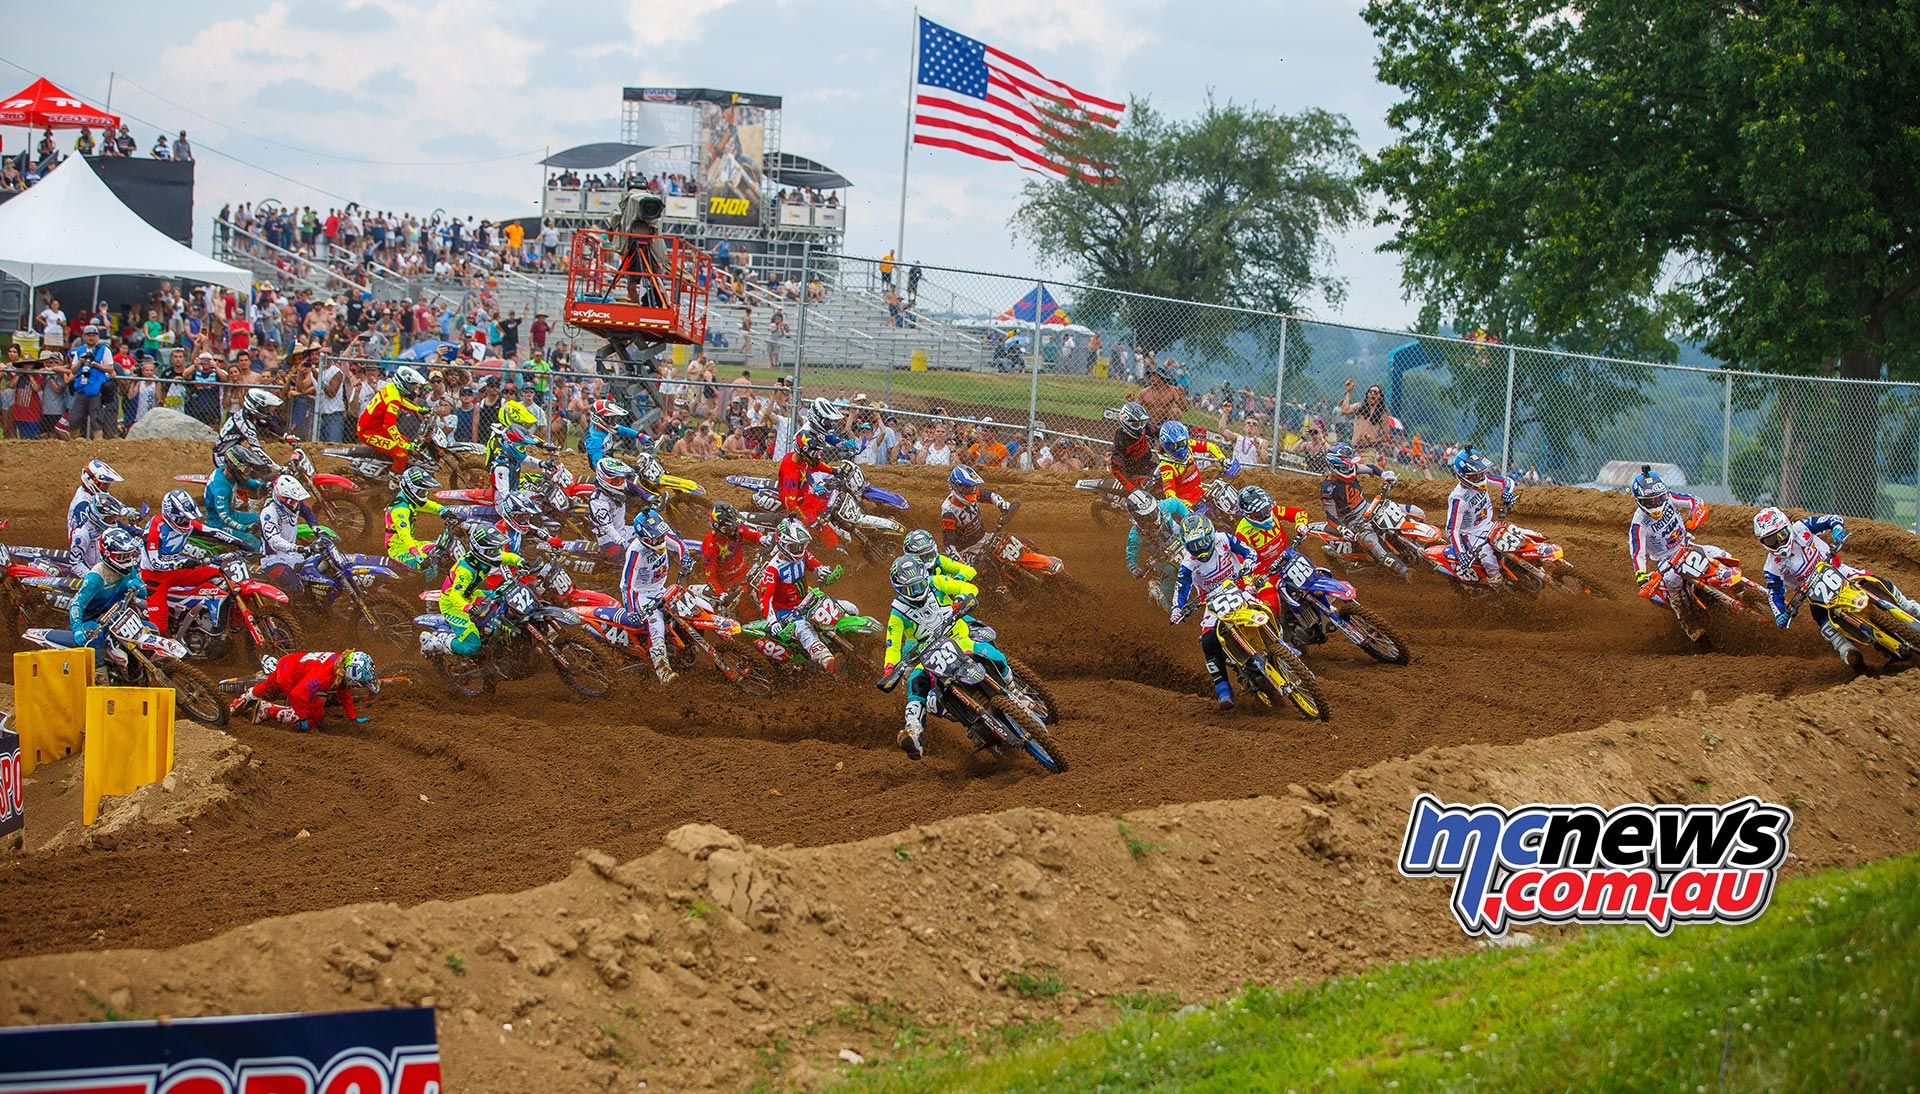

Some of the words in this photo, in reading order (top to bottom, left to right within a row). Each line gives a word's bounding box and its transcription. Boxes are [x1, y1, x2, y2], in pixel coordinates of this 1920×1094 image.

[709, 196, 750, 216] THOR
[571, 308, 611, 319] SKYJACK
[367, 436, 392, 448] FXR
[758, 495, 782, 513] 407
[1377, 503, 1404, 529] 78
[229, 559, 250, 583] 31
[1681, 551, 1709, 578] 12
[198, 588, 218, 596] GEICO
[1814, 569, 1842, 604] 26
[54, 595, 71, 610] 15
[511, 587, 534, 614] 32
[675, 592, 698, 618] 44
[814, 598, 839, 625] 92
[1212, 591, 1244, 617] 55
[120, 615, 142, 640] 981
[605, 626, 629, 647] 44
[763, 638, 786, 661] 92
[929, 640, 958, 675] 39
